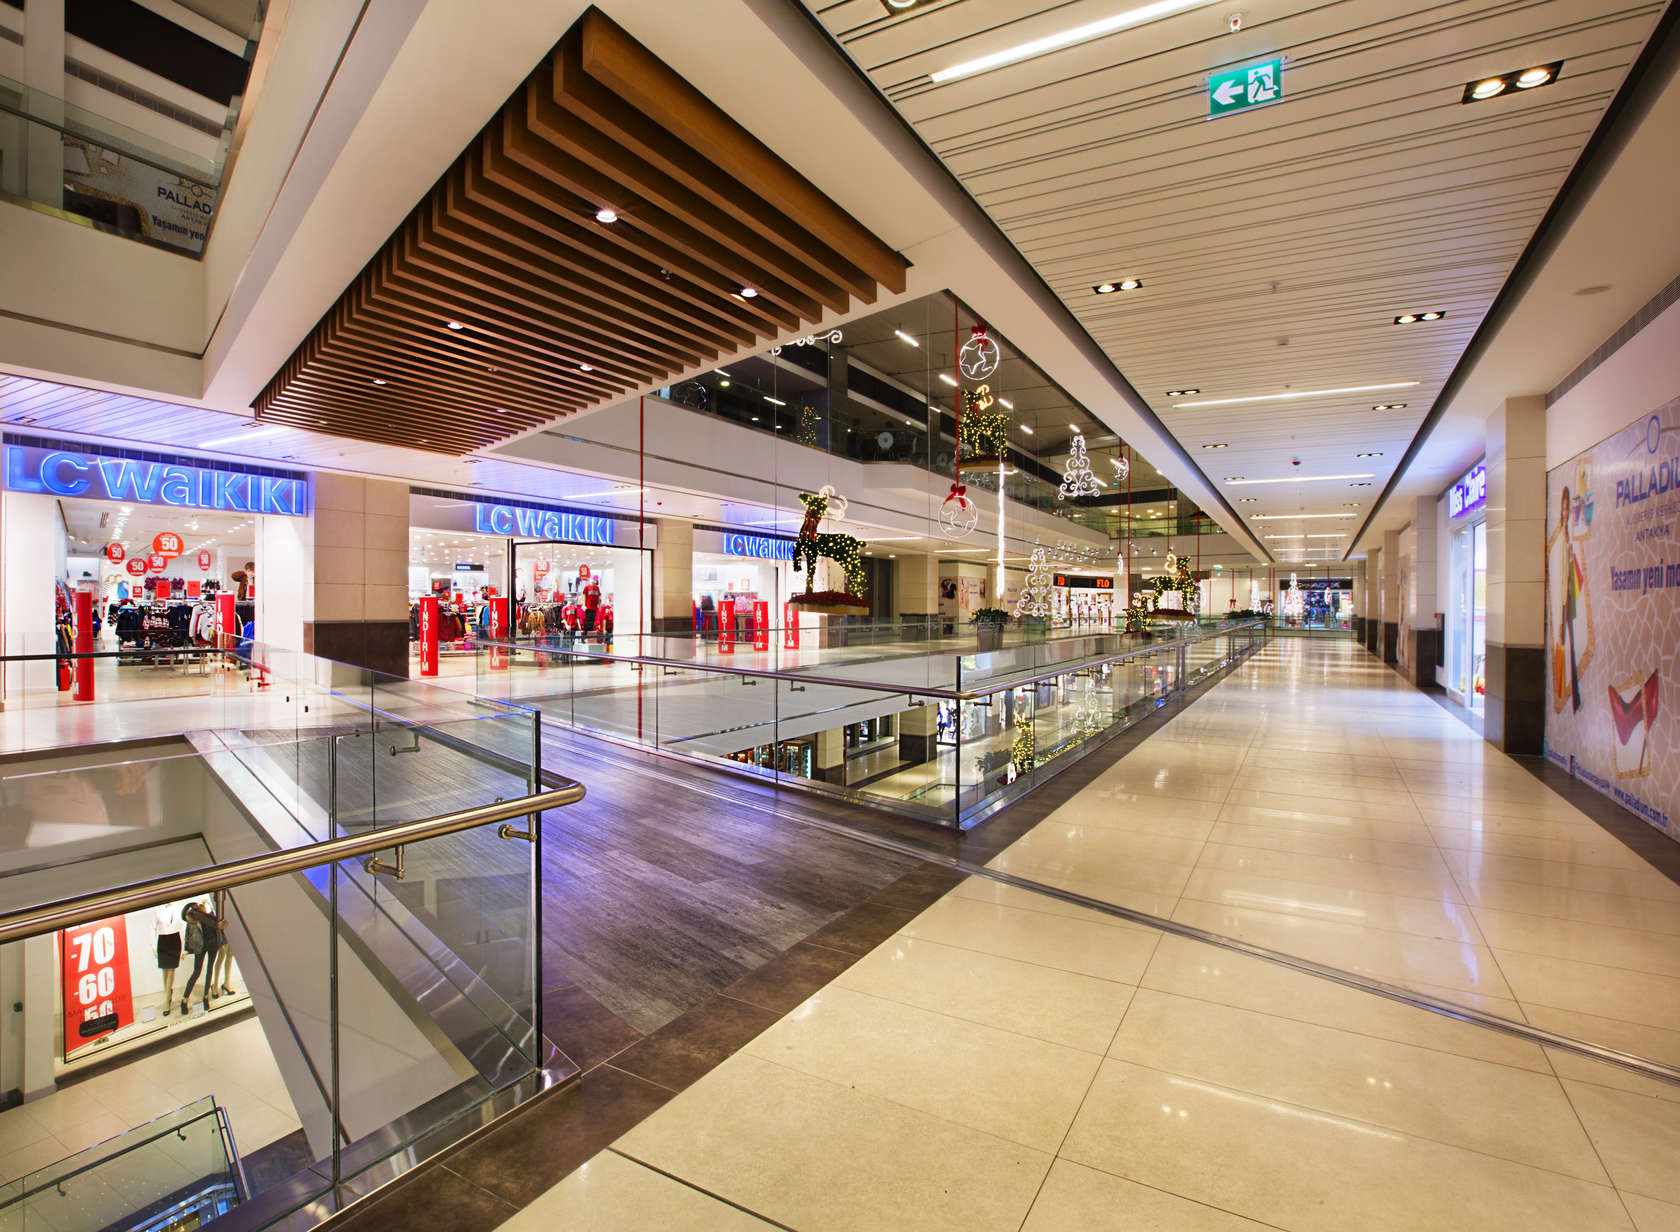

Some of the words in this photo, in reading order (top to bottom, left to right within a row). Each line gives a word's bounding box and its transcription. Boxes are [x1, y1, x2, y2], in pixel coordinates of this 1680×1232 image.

[8, 447, 89, 496] LC
[476, 503, 514, 535] LC
[723, 532, 744, 556] LC
[1096, 578, 1110, 588] FLO
[1642, 558, 1664, 595] yeni
